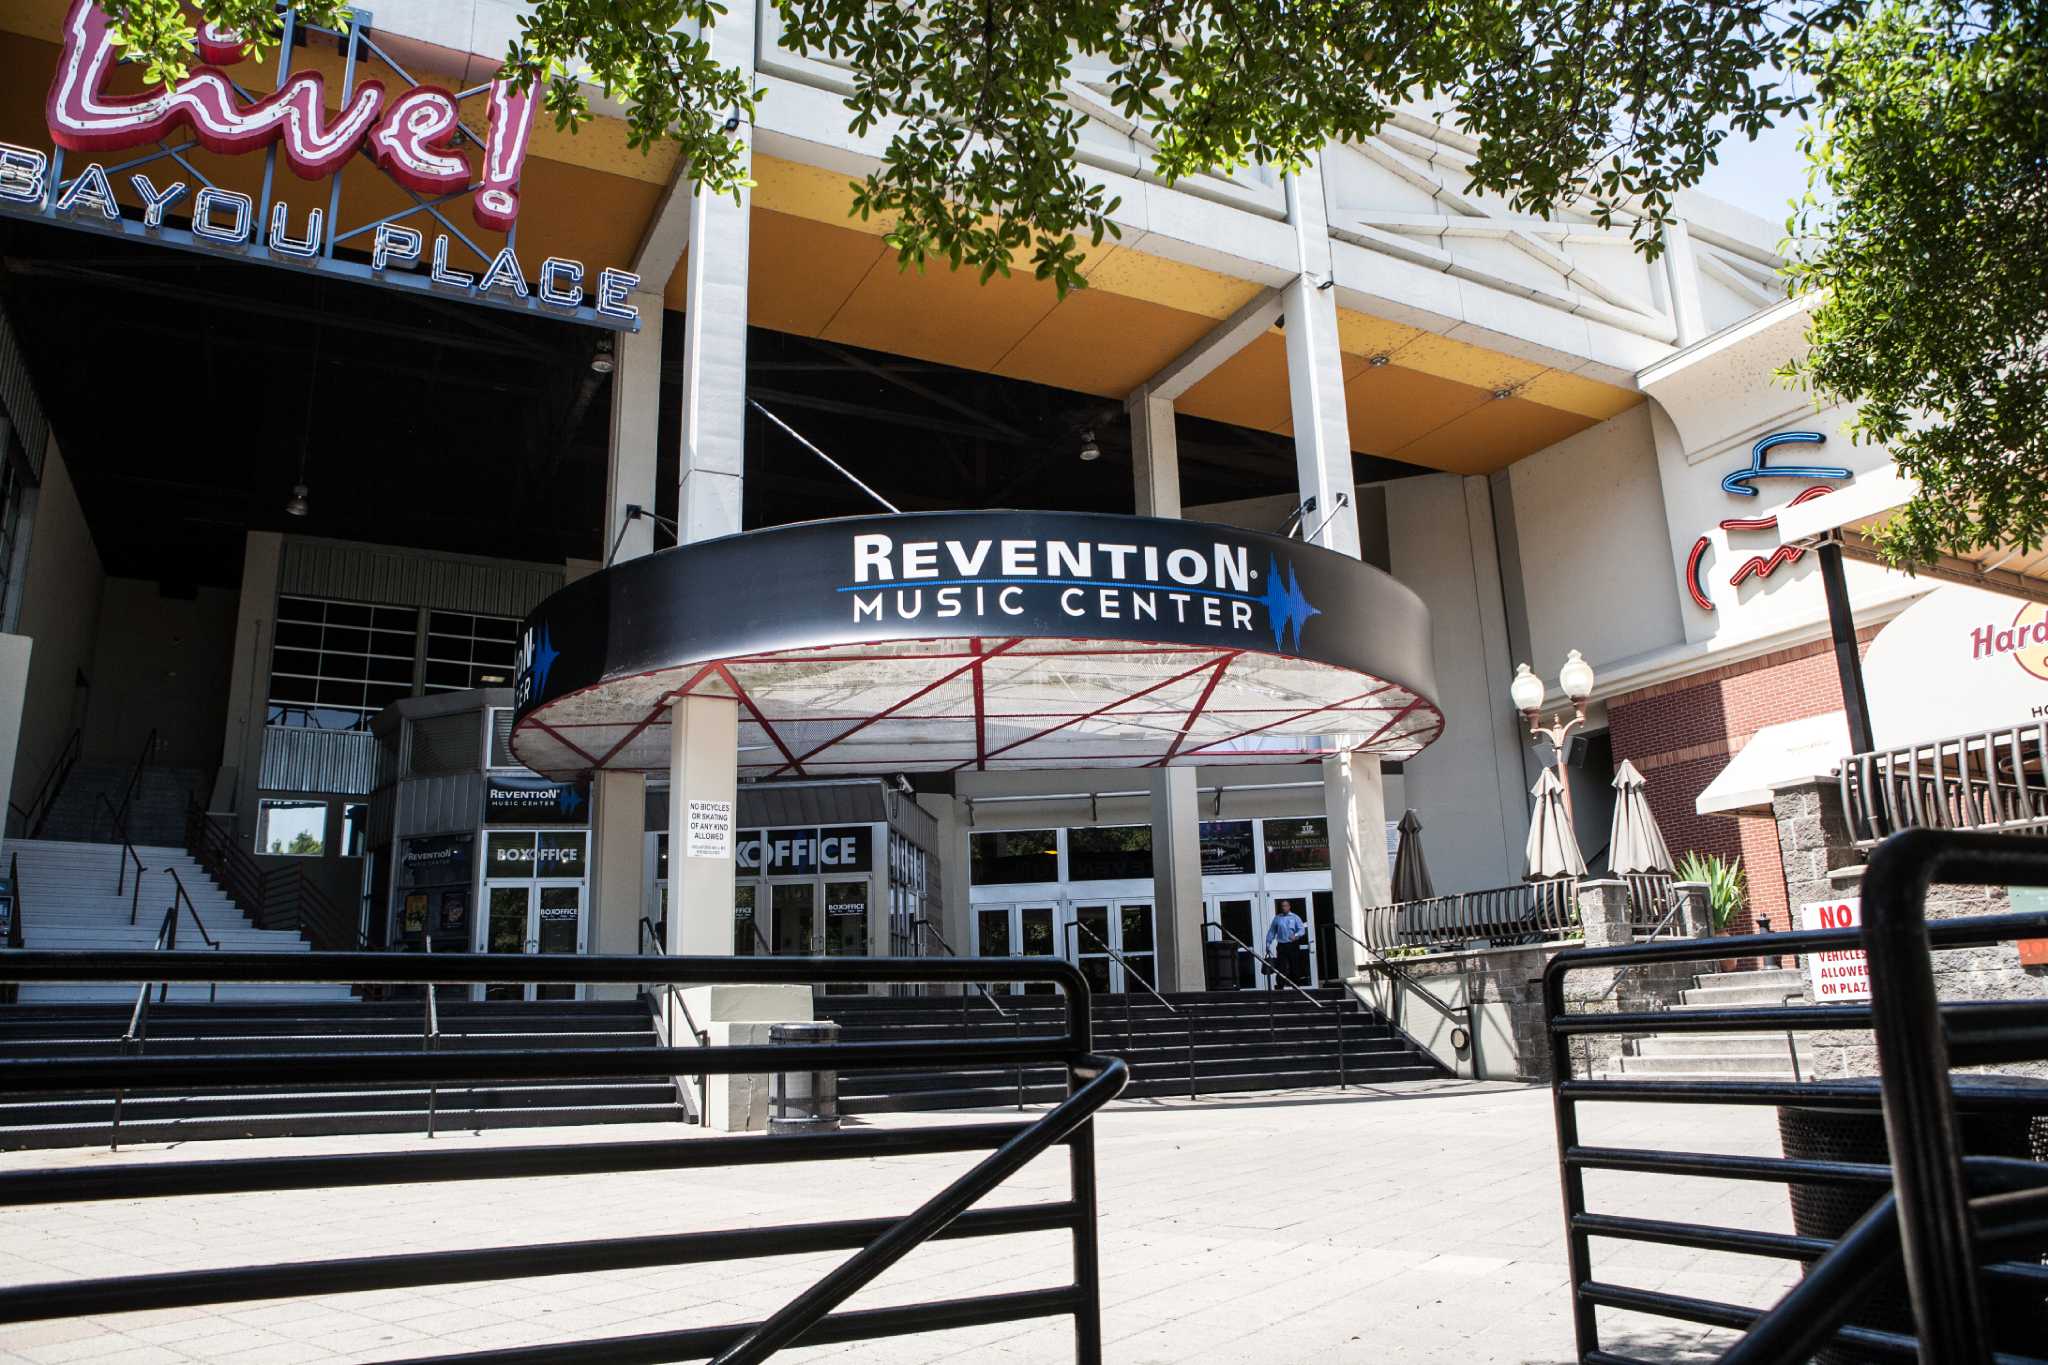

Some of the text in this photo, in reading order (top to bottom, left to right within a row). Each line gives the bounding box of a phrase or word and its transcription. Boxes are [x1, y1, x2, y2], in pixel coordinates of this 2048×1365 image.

[46, 0, 542, 231] Live!
[0, 141, 641, 320] BAYOU PLACE
[853, 533, 1250, 591] REVENTION
[853, 586, 1253, 631] MUSIC CENTER
[1970, 610, 2048, 659] Hard
[490, 788, 557, 799] REVENTION
[690, 802, 729, 811] NO BICYCLES
[692, 812, 728, 821] OR SKATING
[690, 822, 699, 830] OF
[713, 823, 728, 831] KIND
[694, 832, 724, 840] ALLOWED
[1819, 904, 1853, 928] NO
[1819, 950, 1868, 962] VEHICLES
[1822, 982, 1869, 994] ON PLAZ
